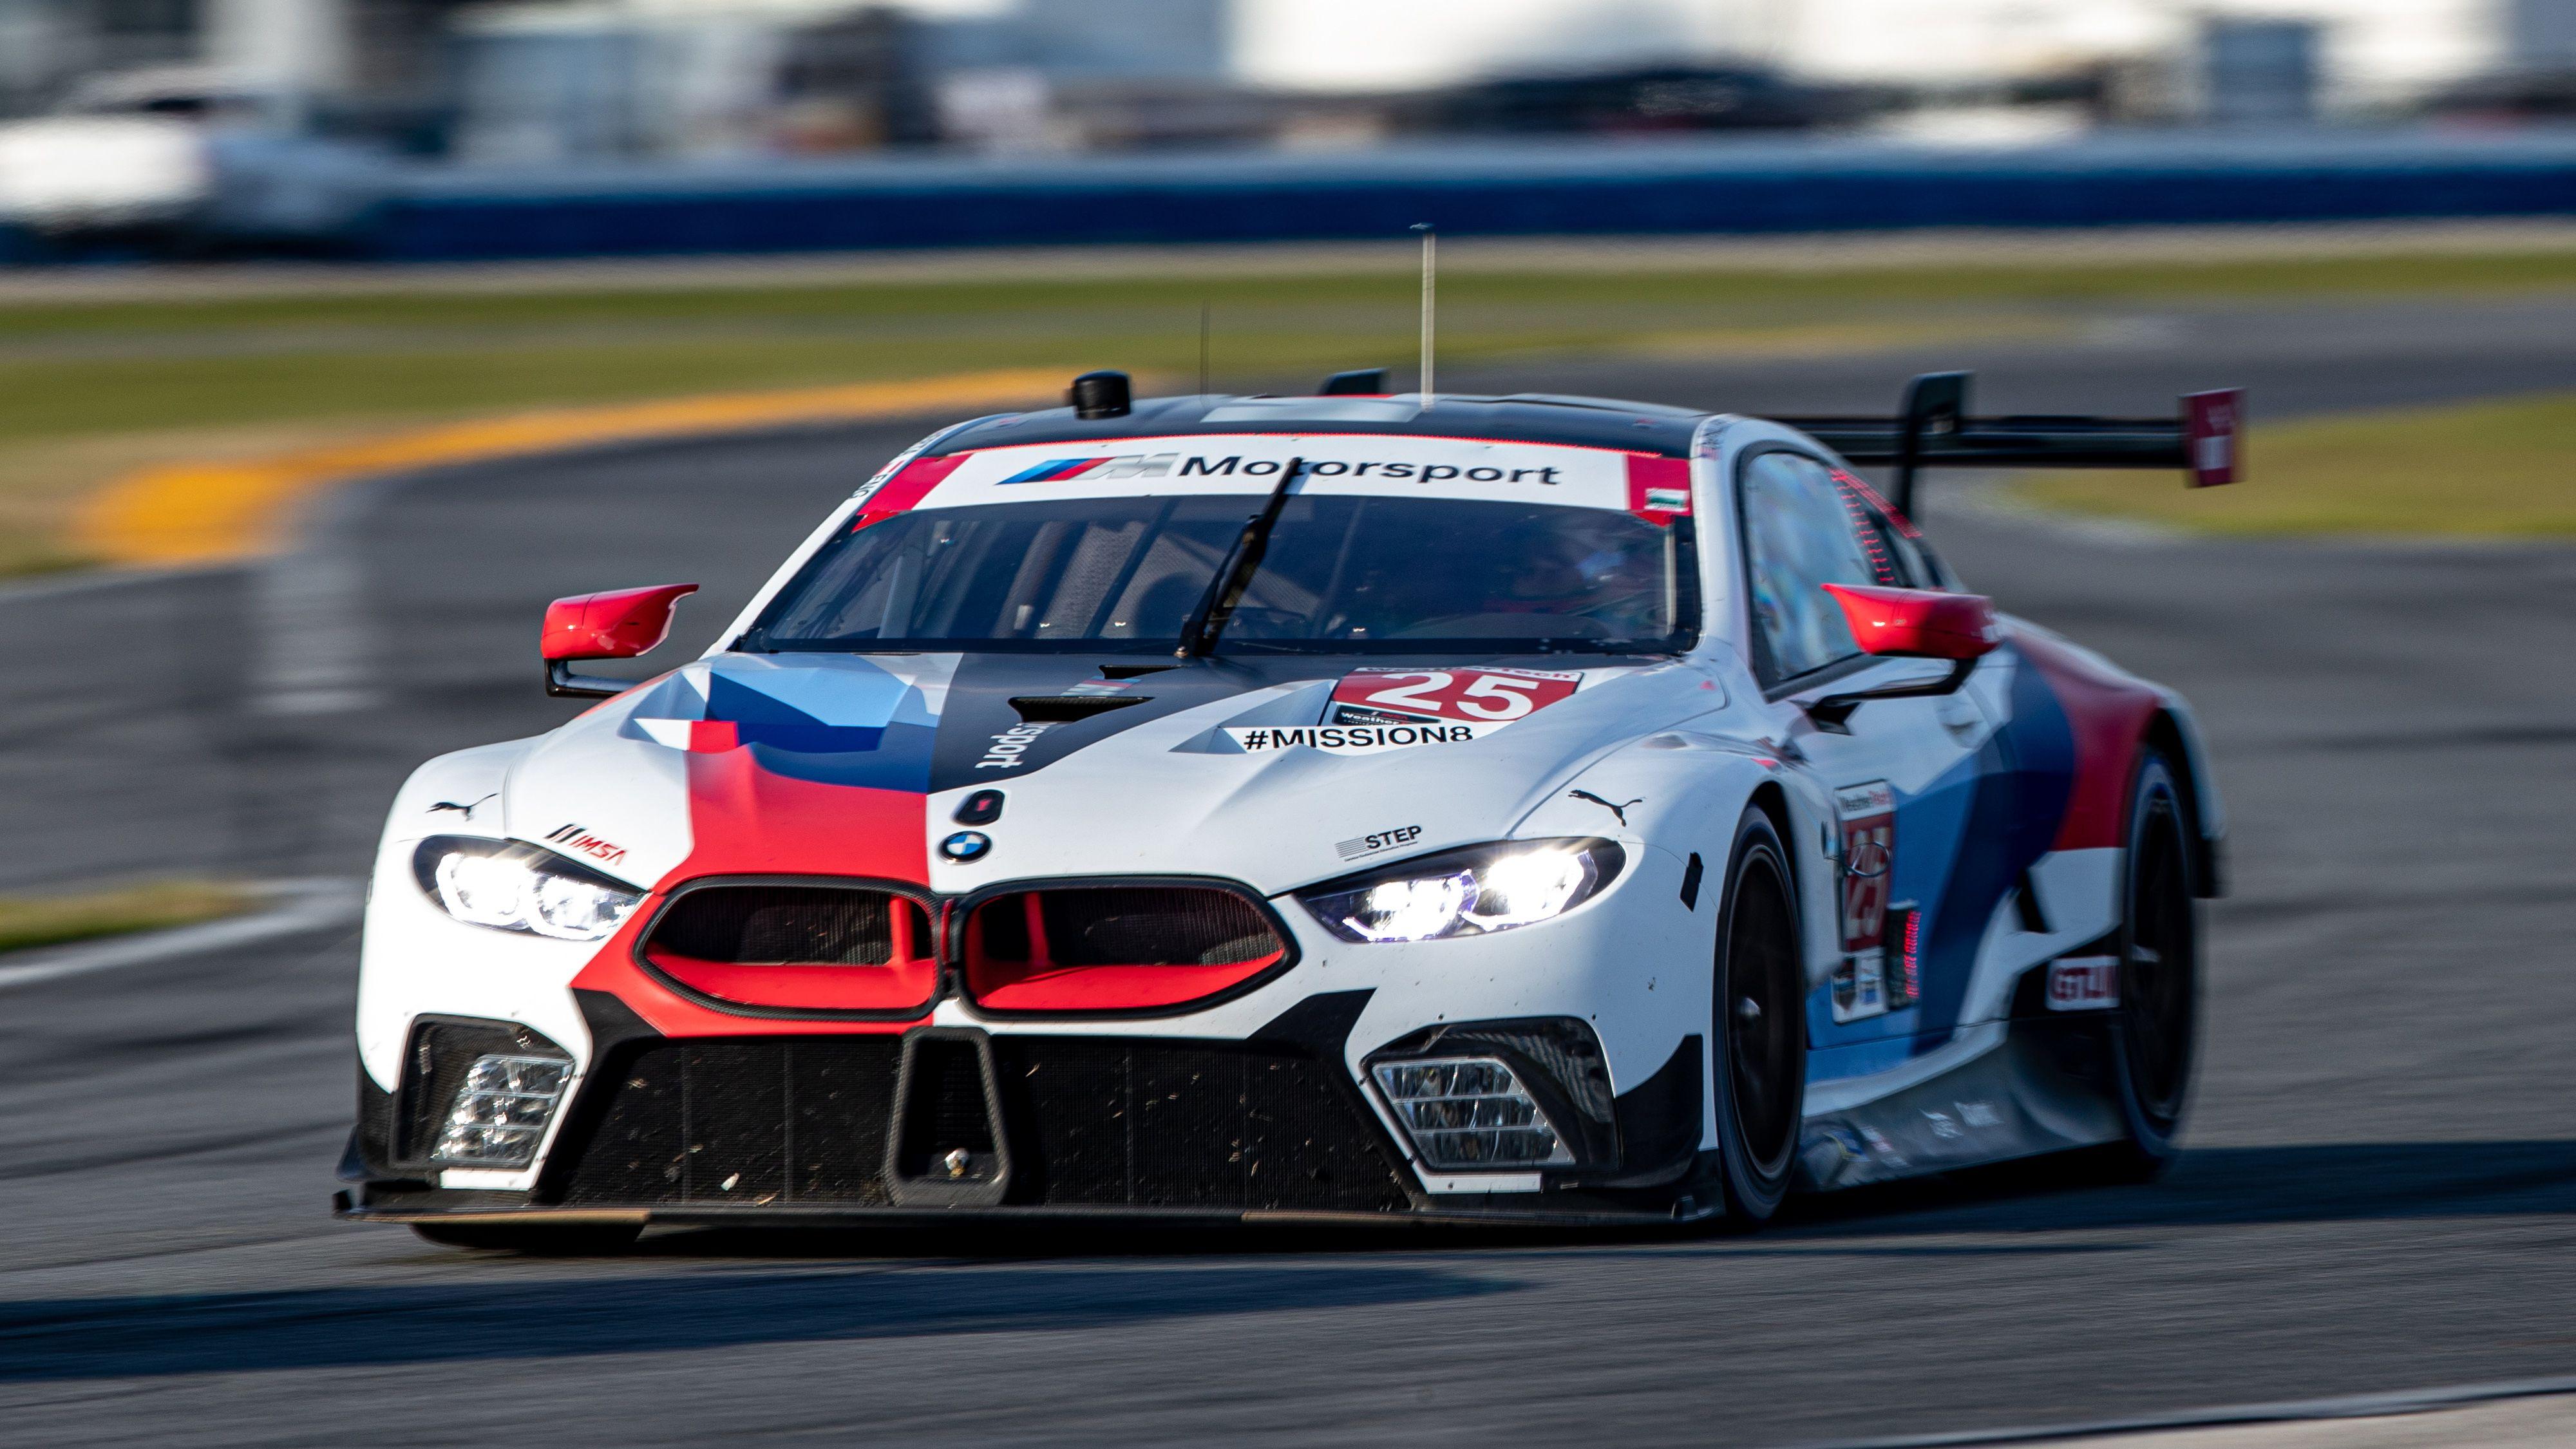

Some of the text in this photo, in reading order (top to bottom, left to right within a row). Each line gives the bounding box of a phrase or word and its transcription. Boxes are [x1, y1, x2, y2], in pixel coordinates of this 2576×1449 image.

[1366, 672, 1540, 720] 25
[1341, 712, 1406, 724] Weather
[1244, 726, 1473, 750] #MISSION8
[1364, 825, 1421, 849] STEP
[568, 835, 628, 866] IMSA
